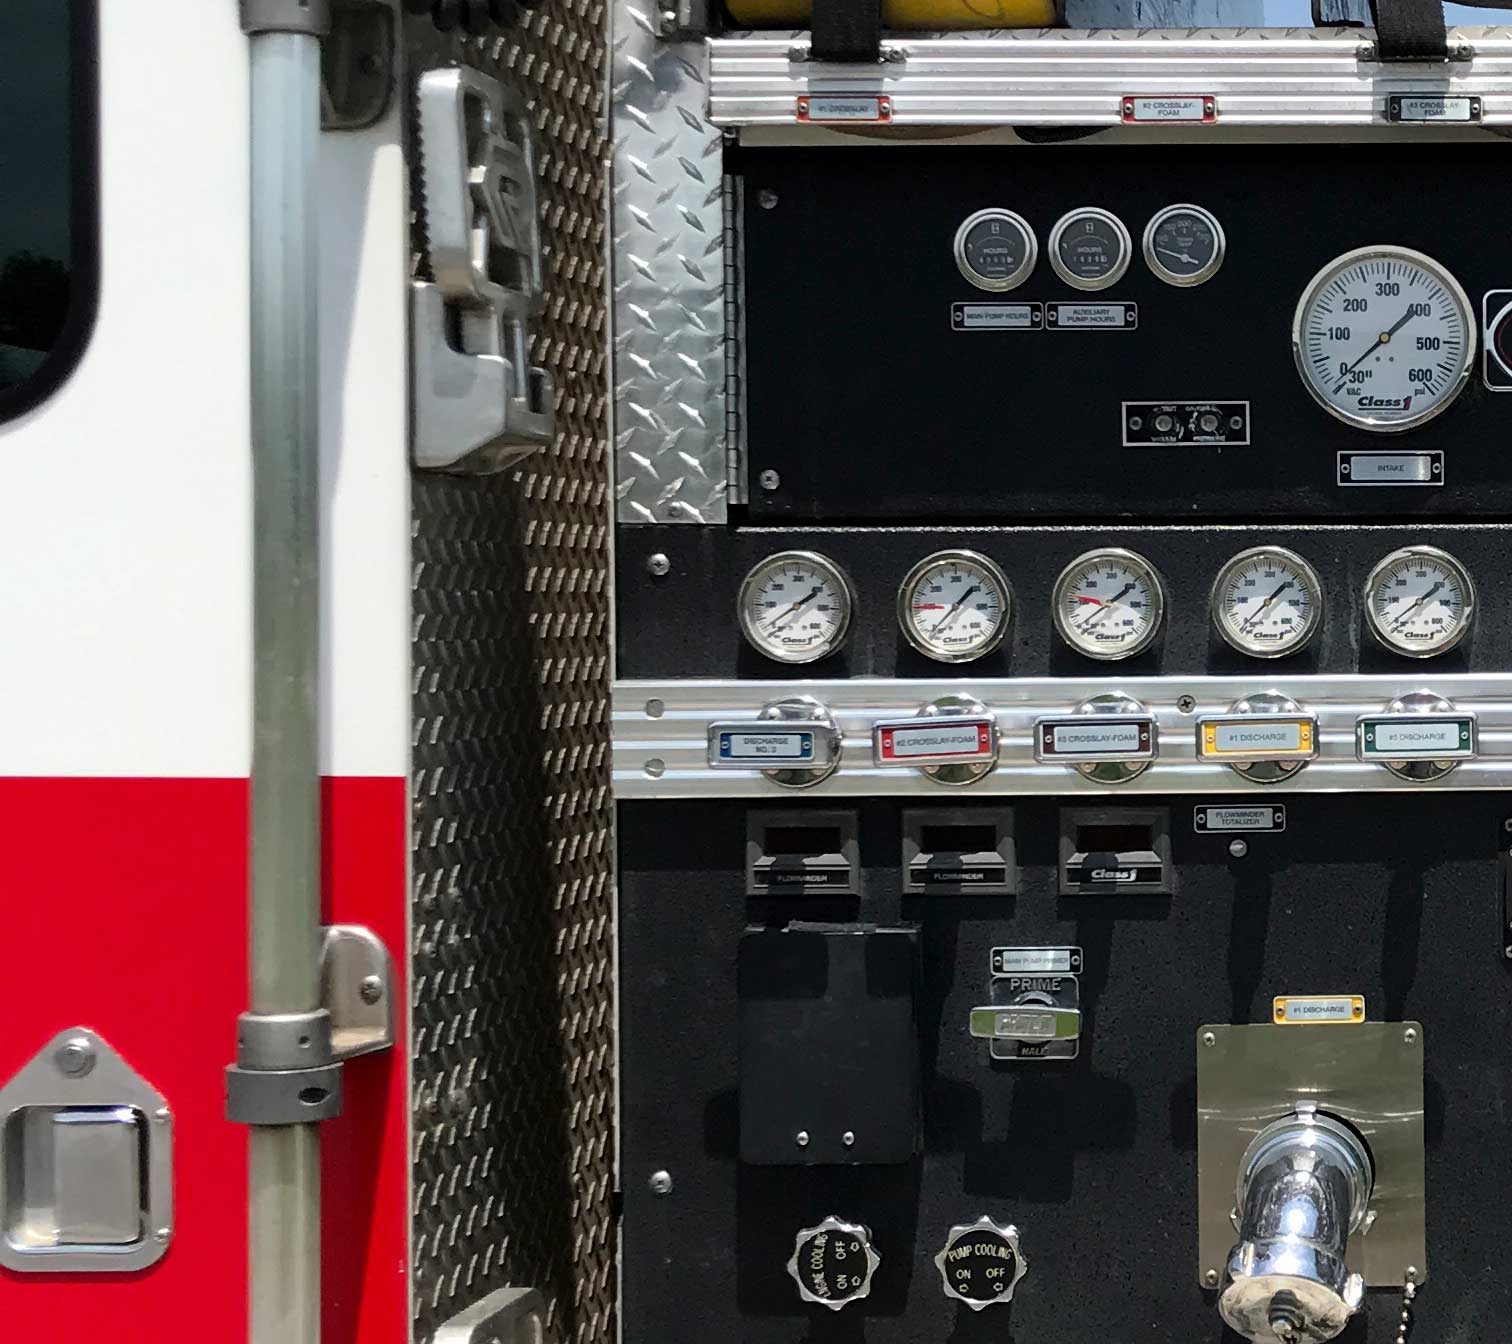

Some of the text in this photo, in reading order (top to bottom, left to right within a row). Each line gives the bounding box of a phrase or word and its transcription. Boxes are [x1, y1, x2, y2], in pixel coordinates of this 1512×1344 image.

[1375, 283, 1399, 296] 300
[1343, 299, 1367, 312] 200
[1090, 315, 1116, 323] HOURS
[1328, 327, 1350, 340] 100
[1416, 337, 1440, 350] 500
[1408, 369, 1433, 382] 600
[1346, 387, 1361, 396] VAC
[1377, 464, 1405, 472] INTAKE
[744, 737, 788, 745] DISCHARGE
[1069, 734, 1136, 743] CROSSLAY-FOAM
[1240, 733, 1287, 741] DISCHARGE
[1400, 733, 1446, 741] DISCHARGE
[1010, 978, 1061, 991] PRIME
[811, 1233, 829, 1270] COOLING
[835, 1240, 846, 1260] OFF
[949, 1243, 1012, 1262] PUMP COOLING
[956, 1267, 1006, 1279] ON OFF
[836, 1274, 848, 1289] ON
